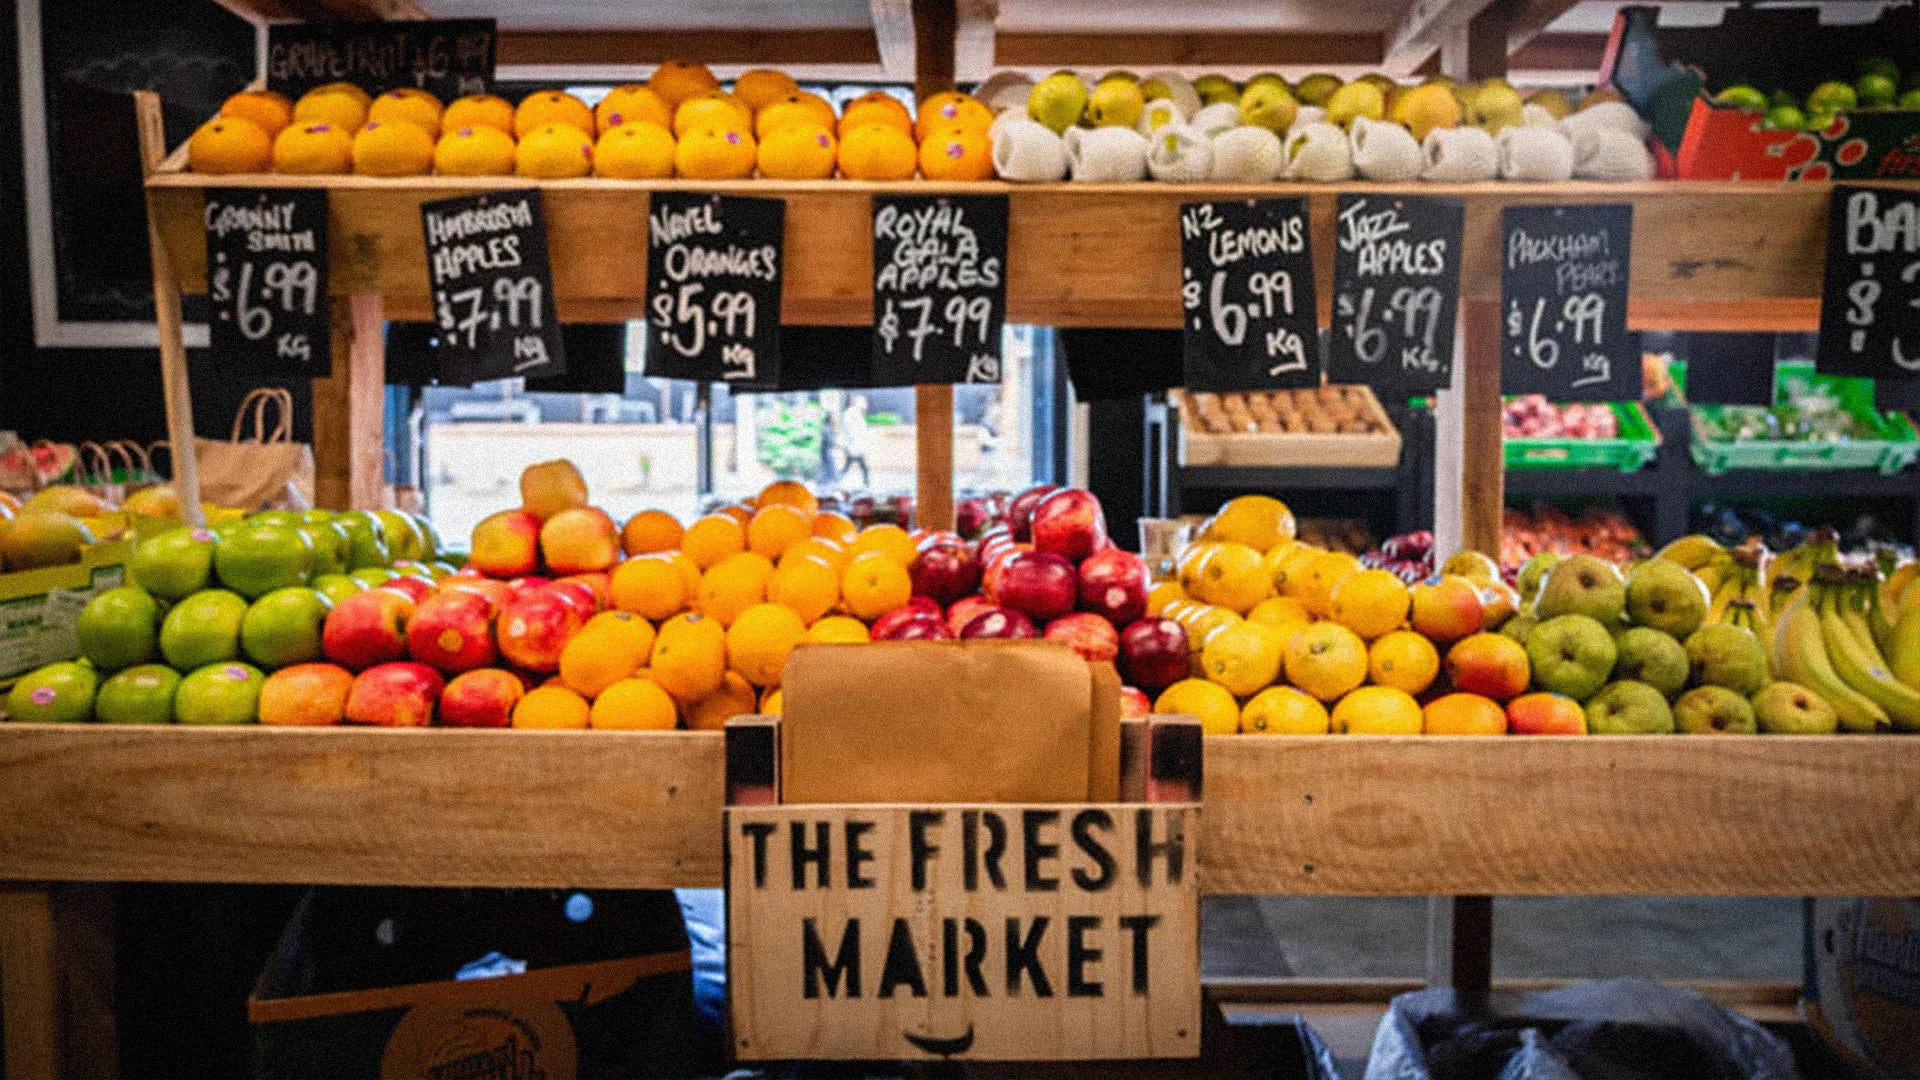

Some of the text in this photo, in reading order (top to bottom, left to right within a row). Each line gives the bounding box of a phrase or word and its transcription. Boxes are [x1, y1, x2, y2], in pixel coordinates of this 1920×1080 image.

[247, 230, 316, 252] SMITH
[650, 204, 723, 247] NAVEL
[875, 204, 966, 244] ROYAL
[1208, 217, 1304, 267] LEMONS
[1846, 191, 1920, 254] BA
[432, 235, 521, 283] APPLES
[665, 244, 776, 281] ORANGES
[894, 230, 979, 268] GALA
[1358, 239, 1447, 277] APPLES
[877, 257, 1000, 292] APPLES
[879, 296, 992, 361] $7.99
[742, 810, 1184, 892] THE FRESH
[802, 916, 1162, 998] MARKET
